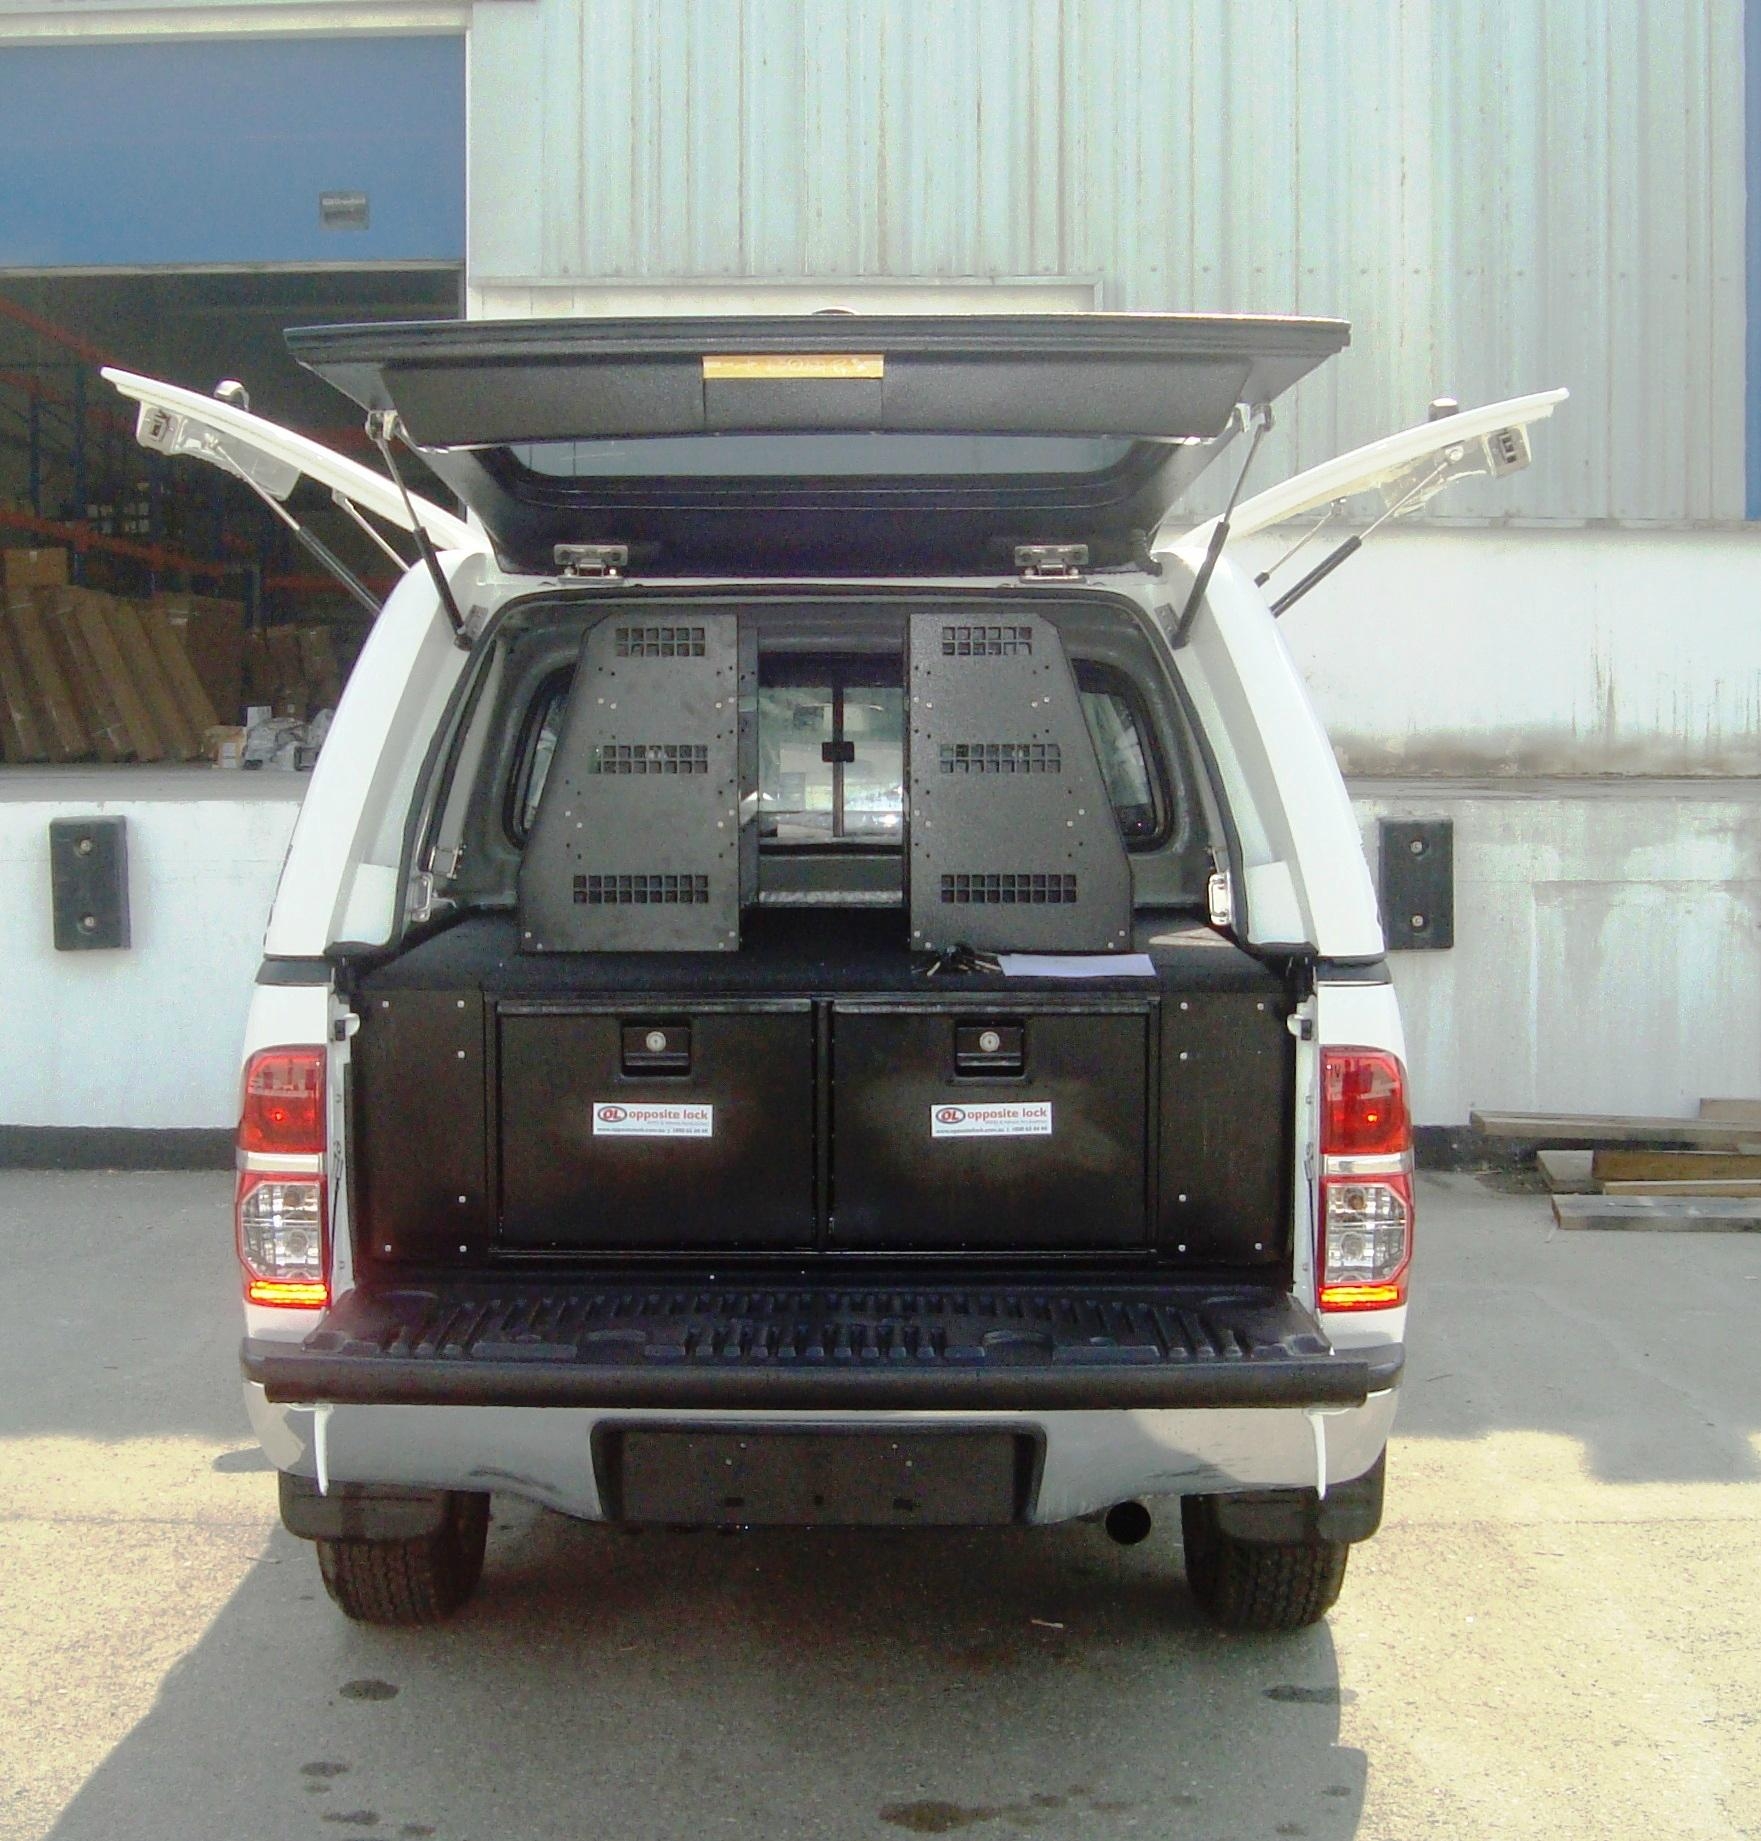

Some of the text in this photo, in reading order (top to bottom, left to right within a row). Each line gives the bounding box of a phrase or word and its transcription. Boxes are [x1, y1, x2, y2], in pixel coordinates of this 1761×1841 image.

[629, 1109, 680, 1121] opposite
[683, 1109, 708, 1120] lock
[967, 1109, 1019, 1121] opposite
[1022, 1108, 1047, 1118] lock
